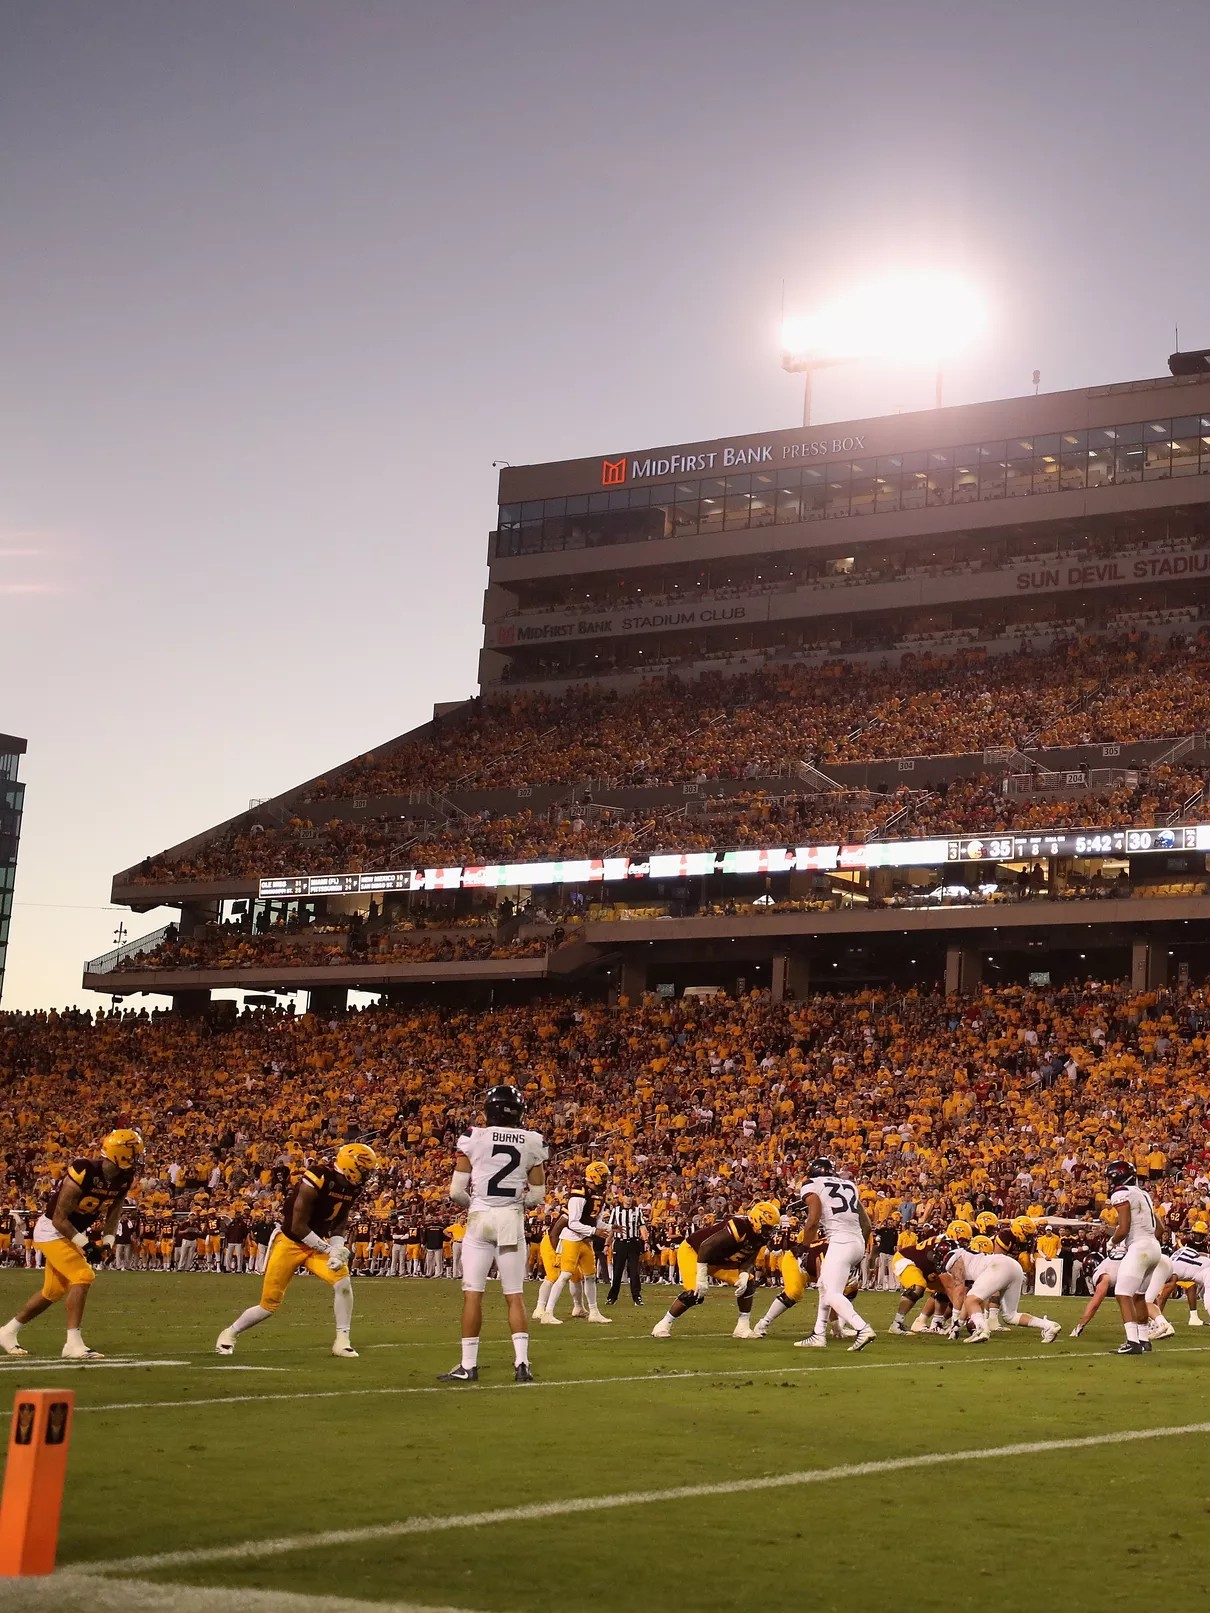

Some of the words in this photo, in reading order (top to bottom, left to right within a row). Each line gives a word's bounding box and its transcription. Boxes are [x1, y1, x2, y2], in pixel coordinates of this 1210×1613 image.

[632, 452, 718, 479] MIDFIRST
[723, 446, 773, 467] BANK
[782, 441, 828, 460] PRESS
[832, 436, 866, 453] BOX
[1016, 570, 1060, 590] SUN
[1068, 563, 1125, 585] DEVIL
[517, 624, 576, 641] MIDFIRST
[578, 620, 612, 635] BANK
[621, 611, 696, 630] STADIUM
[700, 607, 746, 622] CLUB
[1104, 747, 1119, 756] 305
[899, 762, 913, 770] 304
[1068, 774, 1083, 783] 204
[519, 789, 531, 797] 302
[684, 785, 697, 794] 303
[1075, 835, 1112, 853] 5:42
[1114, 839, 1123, 850] 4
[1129, 832, 1151, 850] 30
[1186, 835, 1195, 847] 2
[949, 848, 958, 860] 3
[989, 840, 1011, 857] 35
[1017, 845, 1024, 857] 1
[1031, 843, 1040, 856] 8
[1050, 842, 1059, 855] 8
[492, 1132, 525, 1144] BURNS
[487, 1144, 521, 1197] 2
[824, 1182, 859, 1216] 32
[1169, 1212, 1181, 1221] 52
